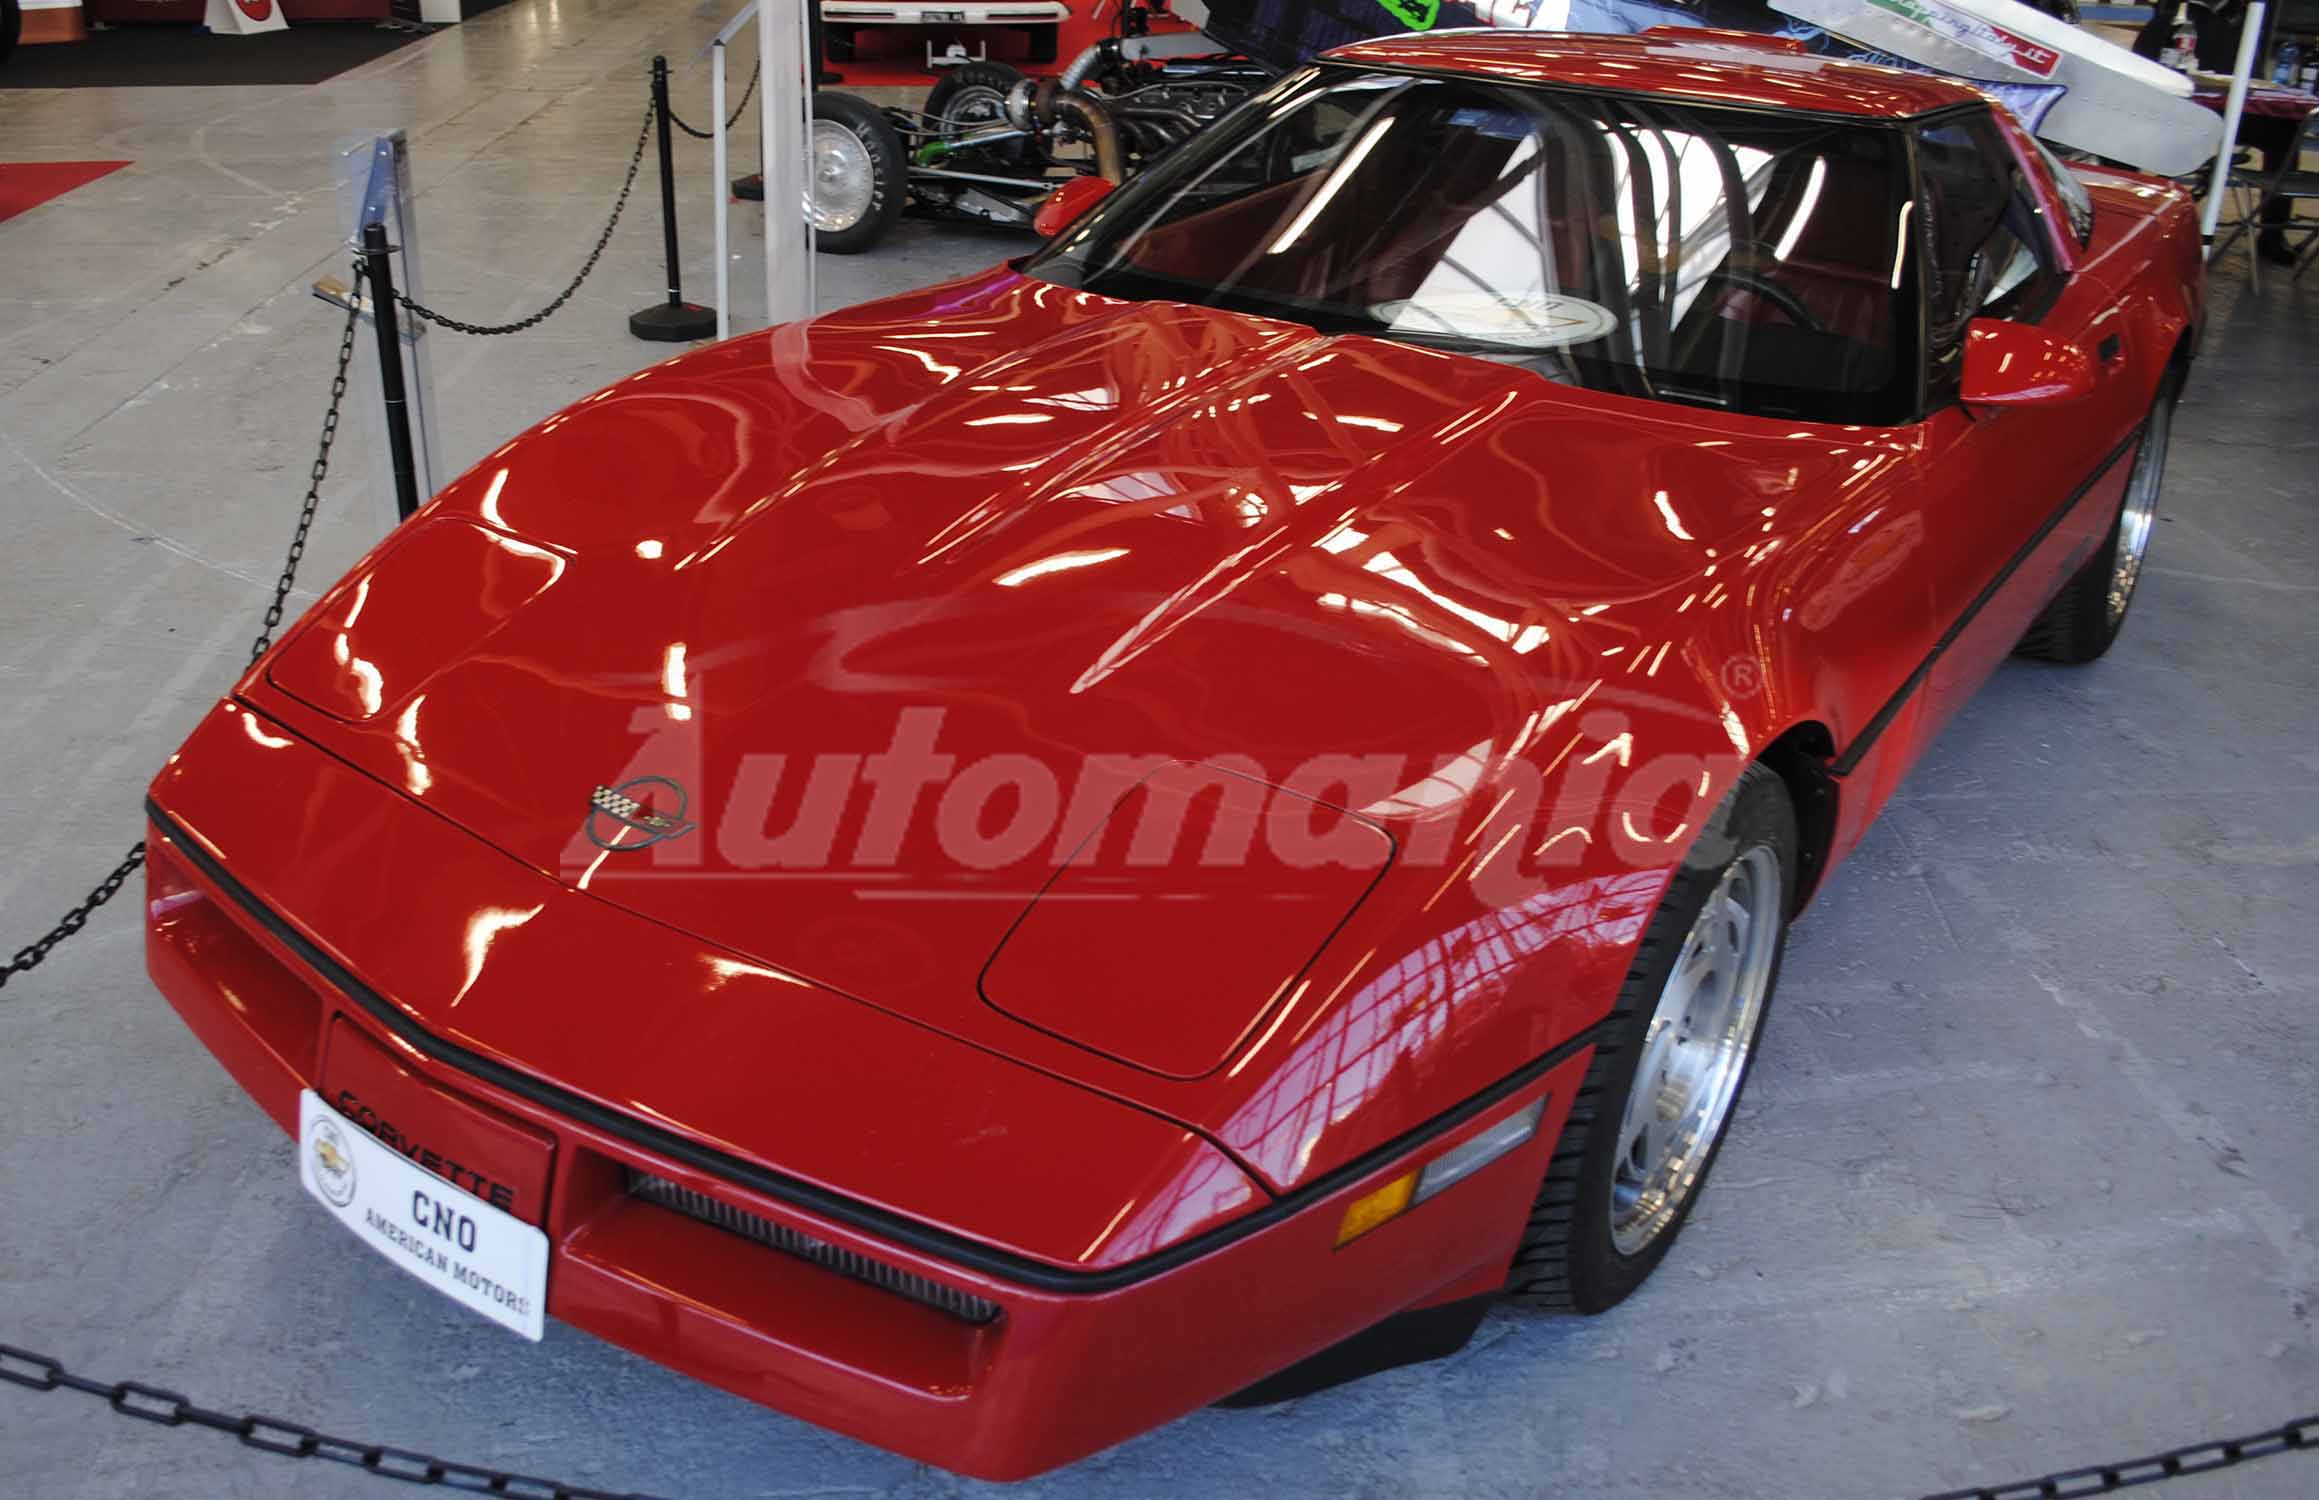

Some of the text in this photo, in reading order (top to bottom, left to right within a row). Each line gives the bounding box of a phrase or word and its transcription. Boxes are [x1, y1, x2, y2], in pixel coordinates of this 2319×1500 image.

[338, 1089, 515, 1213] CORVETTE
[365, 1207, 531, 1315] AMERICAN MOTORS
[413, 1189, 477, 1253] CNO
